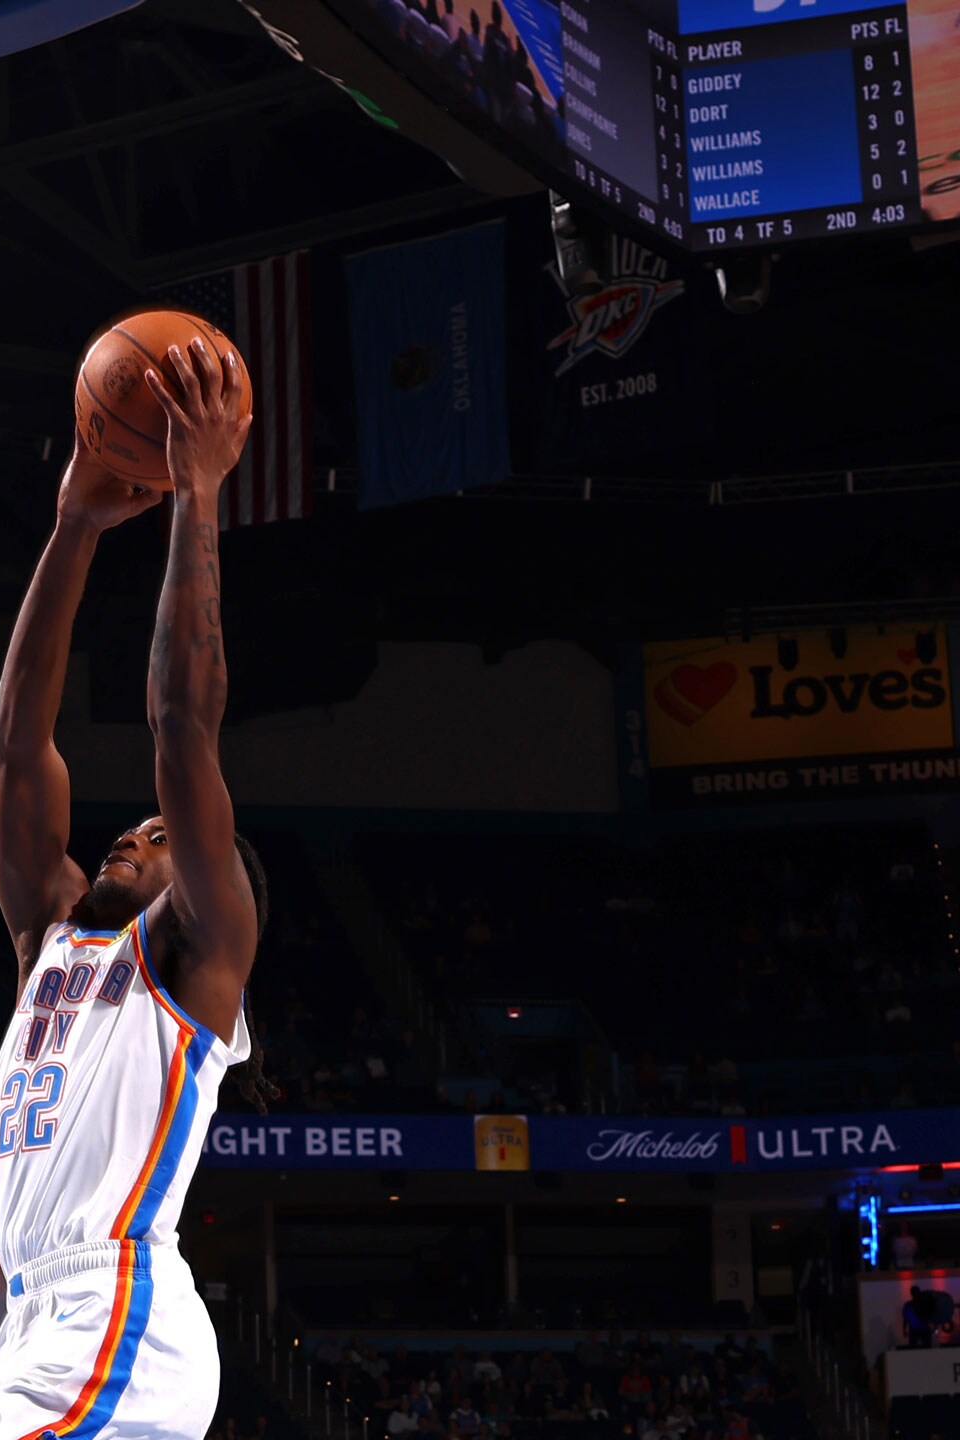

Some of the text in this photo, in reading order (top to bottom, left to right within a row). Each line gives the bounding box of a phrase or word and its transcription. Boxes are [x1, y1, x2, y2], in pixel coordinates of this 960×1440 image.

[687, 17, 903, 62] PLAYER PTS FL
[688, 51, 900, 94] GIDDEY 8 1
[689, 80, 903, 124] DORT 12 2
[691, 110, 904, 152] WILLIAMS 3 0
[692, 139, 907, 182] WILLIAMS 5 2
[694, 170, 908, 211] WALLACE 0 1
[706, 204, 905, 244] TO 4 TF 5 2ND 4:03
[450, 301, 471, 411] OKLAHOMA
[580, 372, 657, 408] EST. 2008
[692, 757, 960, 796] BRING THE THUN
[305, 1126, 404, 1157] BEER
[586, 1124, 897, 1161] Michelob ULTRA
